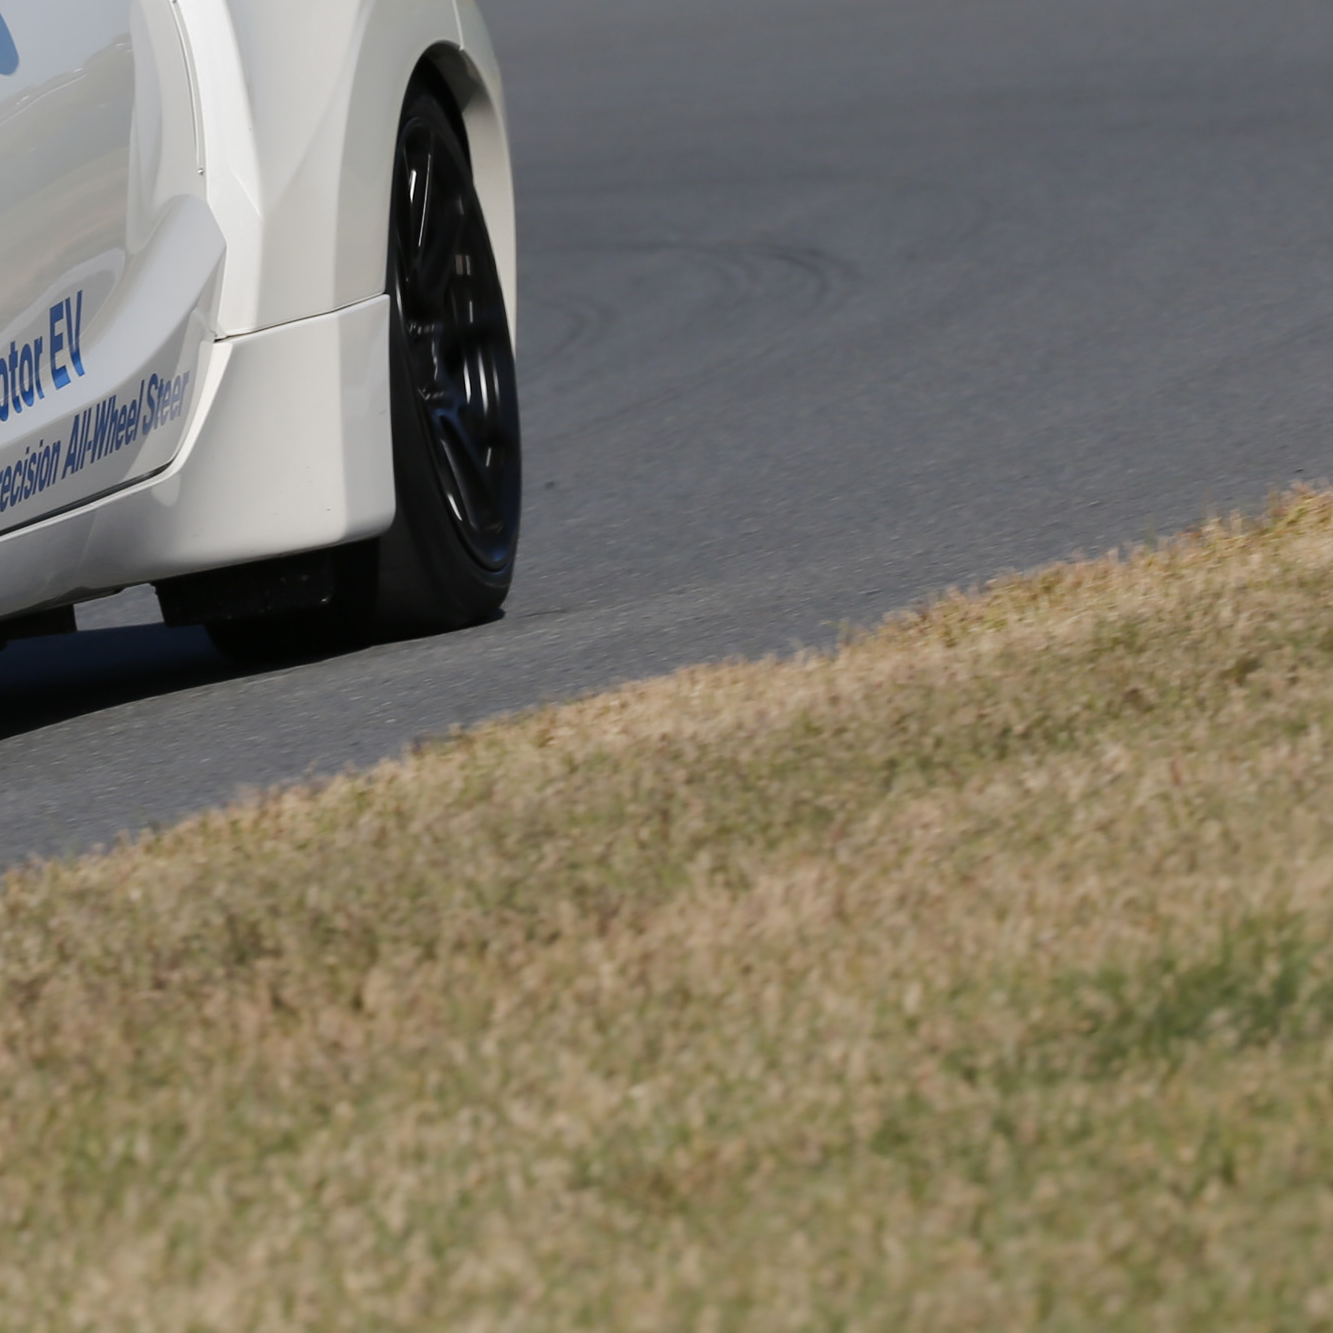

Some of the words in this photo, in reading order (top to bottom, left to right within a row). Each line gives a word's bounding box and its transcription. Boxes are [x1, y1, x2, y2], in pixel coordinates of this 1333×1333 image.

[49, 289, 85, 391] EV
[60, 379, 146, 481] All-Wheel
[142, 370, 191, 436] Steer
